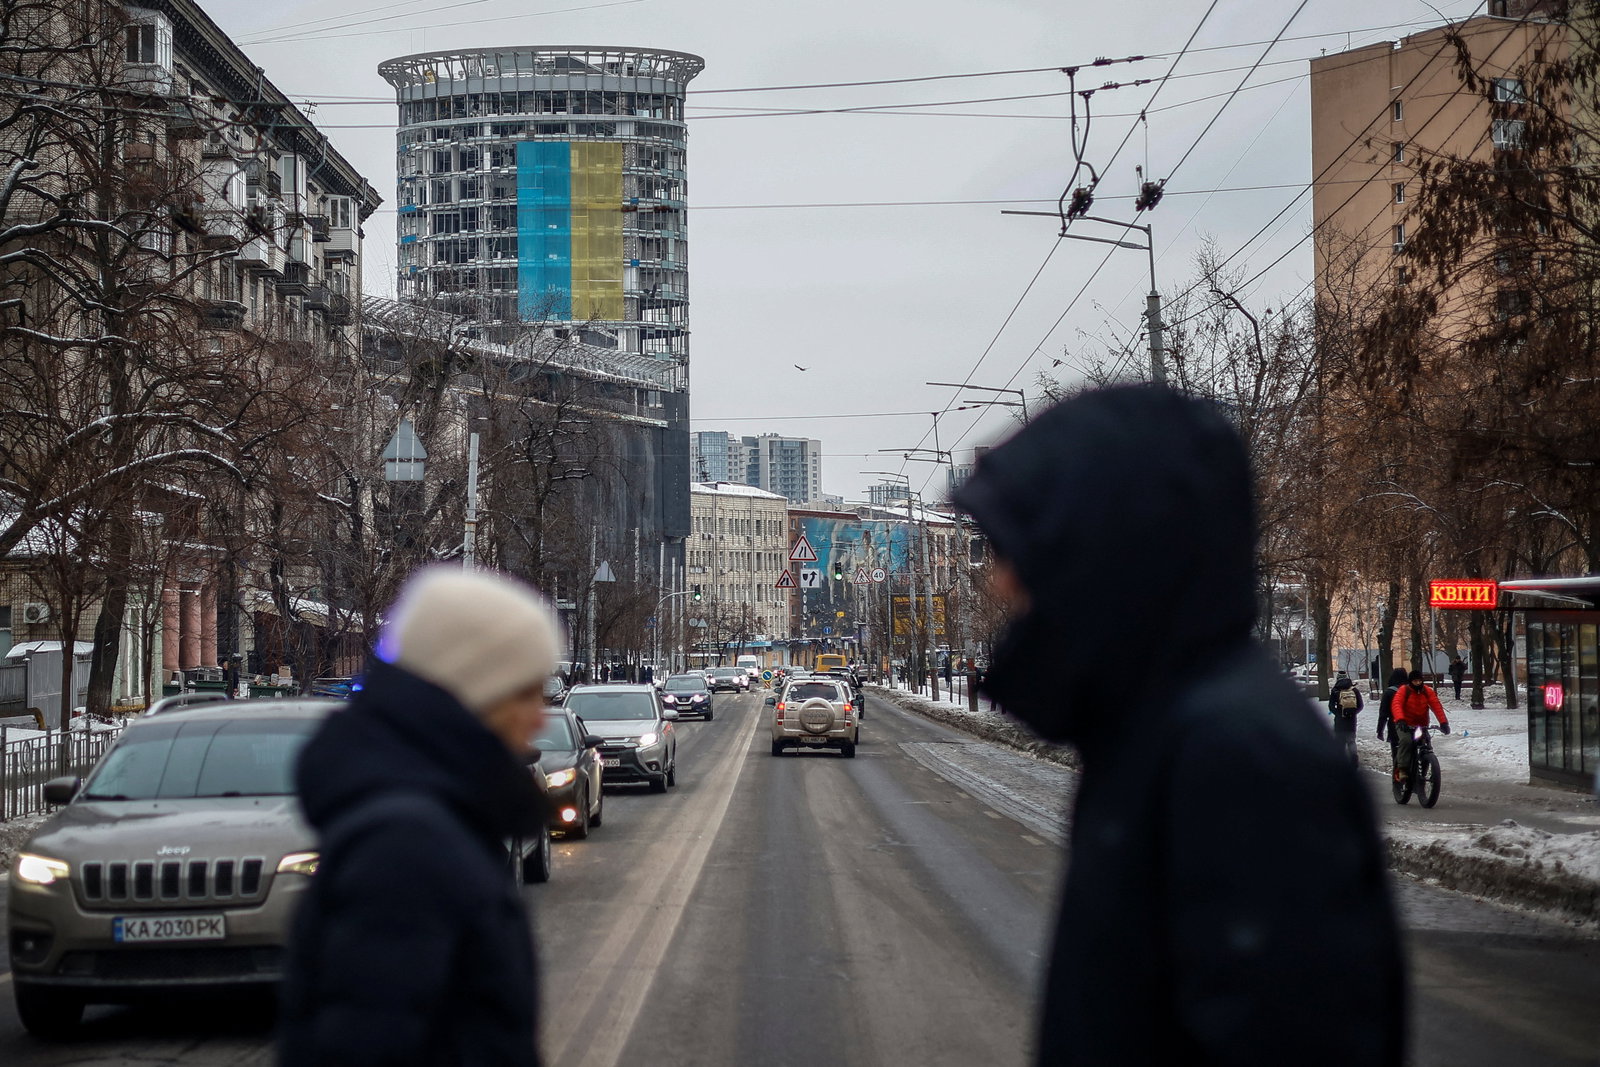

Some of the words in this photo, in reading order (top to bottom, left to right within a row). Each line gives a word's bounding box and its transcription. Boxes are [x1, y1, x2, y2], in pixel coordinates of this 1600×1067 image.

[1431, 586, 1490, 602] КВІТИ
[157, 846, 191, 856] Jeep
[124, 920, 150, 938] KA
[153, 920, 194, 938] 2030
[197, 918, 221, 935] PK
